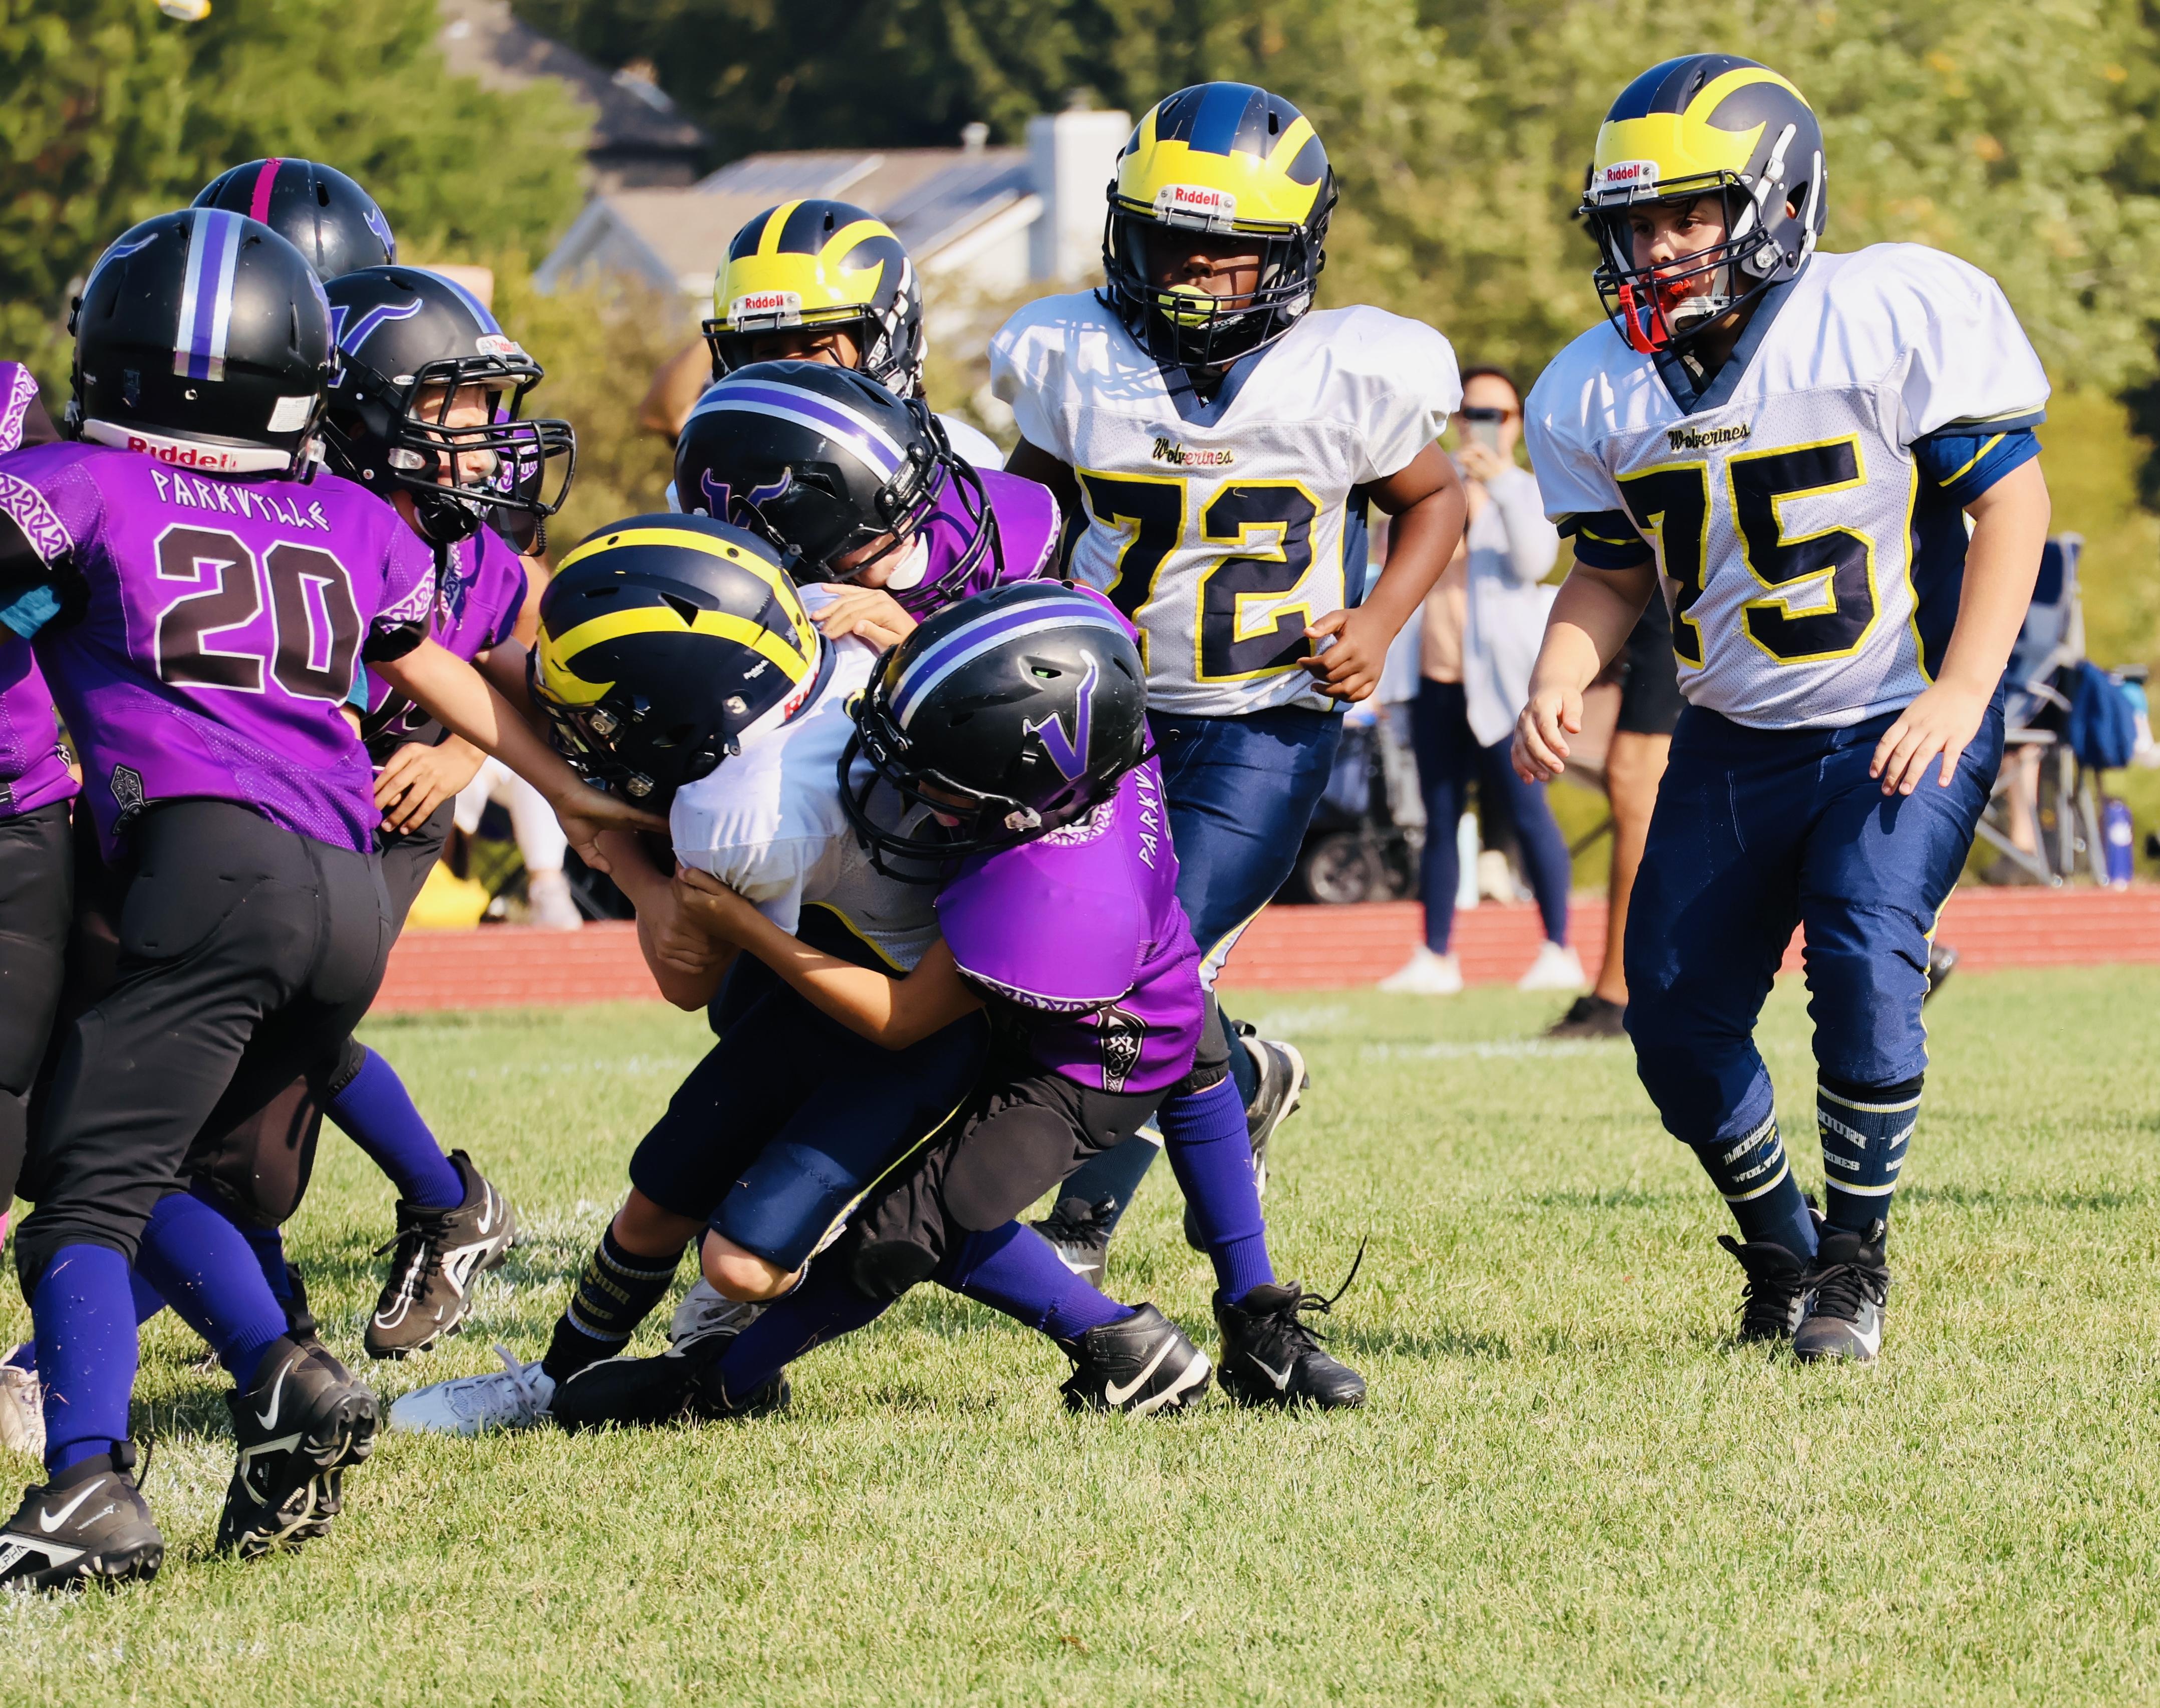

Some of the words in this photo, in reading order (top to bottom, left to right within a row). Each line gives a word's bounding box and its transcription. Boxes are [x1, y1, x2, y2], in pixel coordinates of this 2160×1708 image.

[1607, 164, 1641, 182] Riddell
[1175, 187, 1220, 206] Riddell
[745, 295, 783, 309] Riddell
[1152, 437, 1234, 465] Wolverines
[1667, 422, 1751, 451] Wolverines
[149, 468, 332, 532] PARKVILLE
[1614, 431, 1882, 670] 75
[1075, 465, 1324, 683] 72
[153, 522, 364, 708] 20
